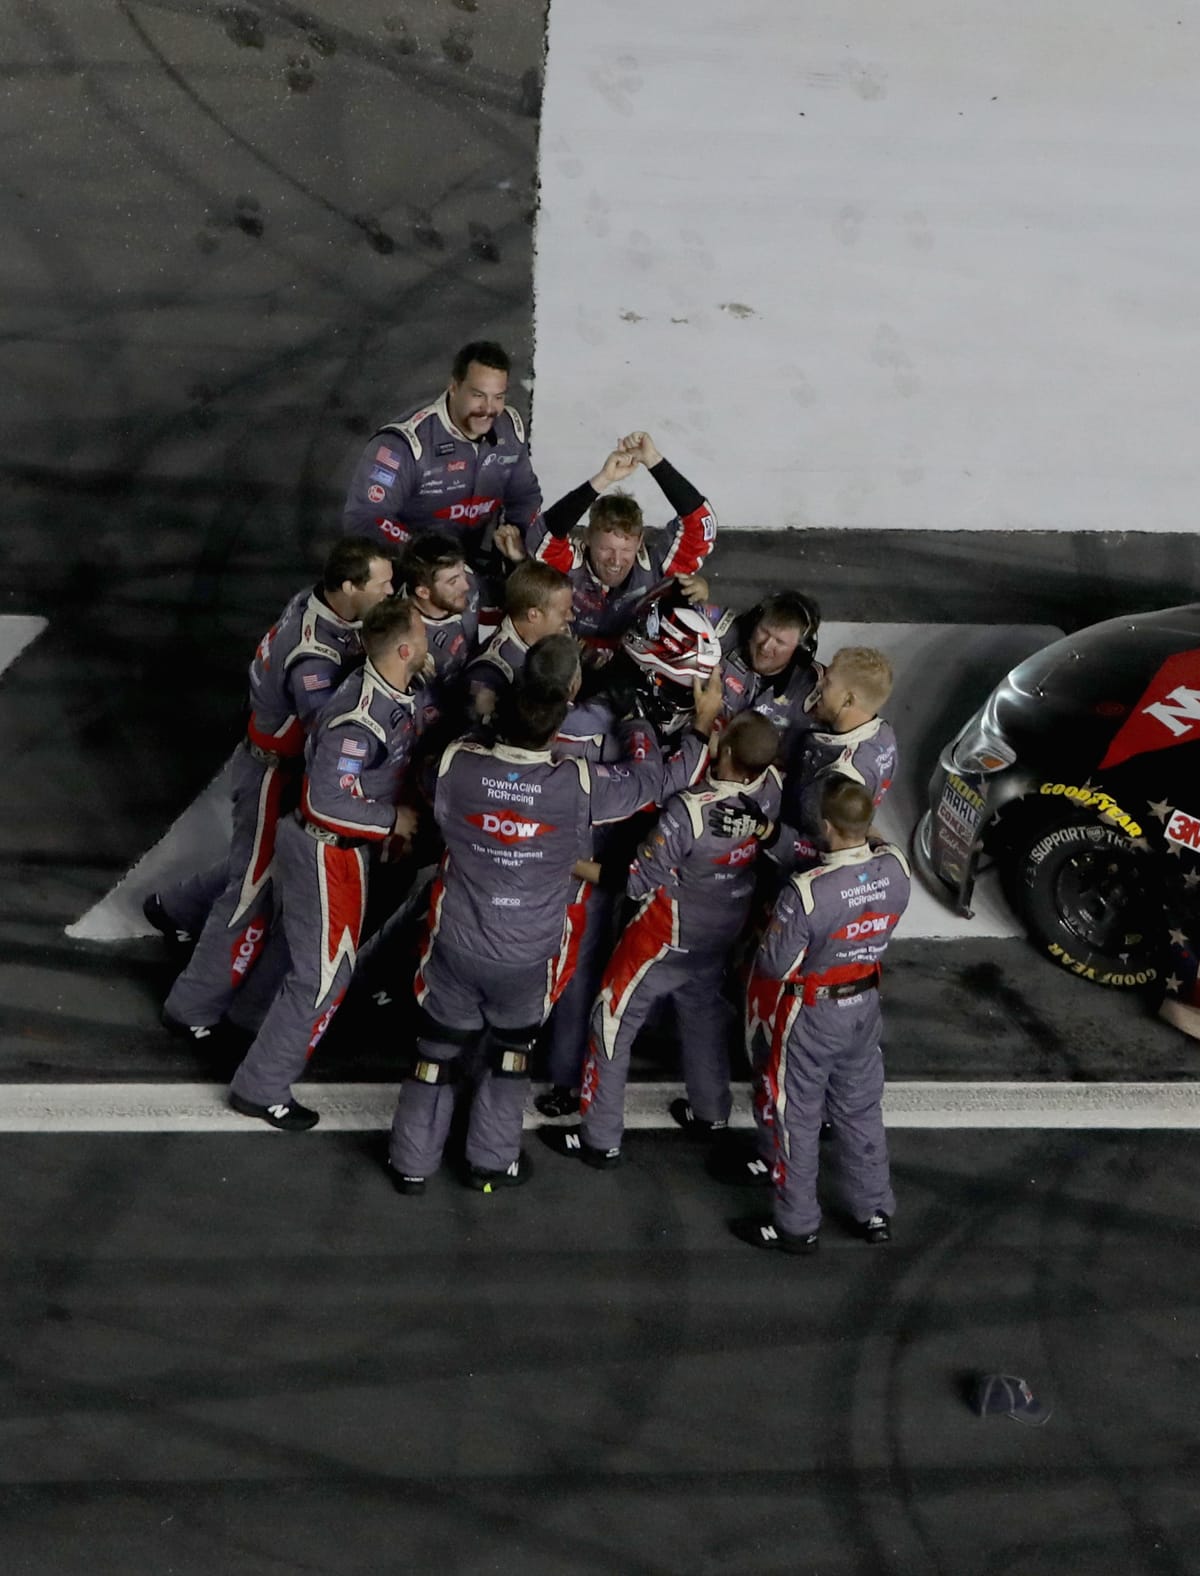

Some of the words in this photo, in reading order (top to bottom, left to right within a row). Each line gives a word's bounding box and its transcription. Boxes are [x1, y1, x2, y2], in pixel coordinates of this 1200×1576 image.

[482, 814, 540, 837] DOW
[1040, 782, 1143, 838] GOODYEAR
[1031, 827, 1087, 864] SUPPORT
[233, 926, 264, 965] DOW
[846, 916, 890, 939] DOW
